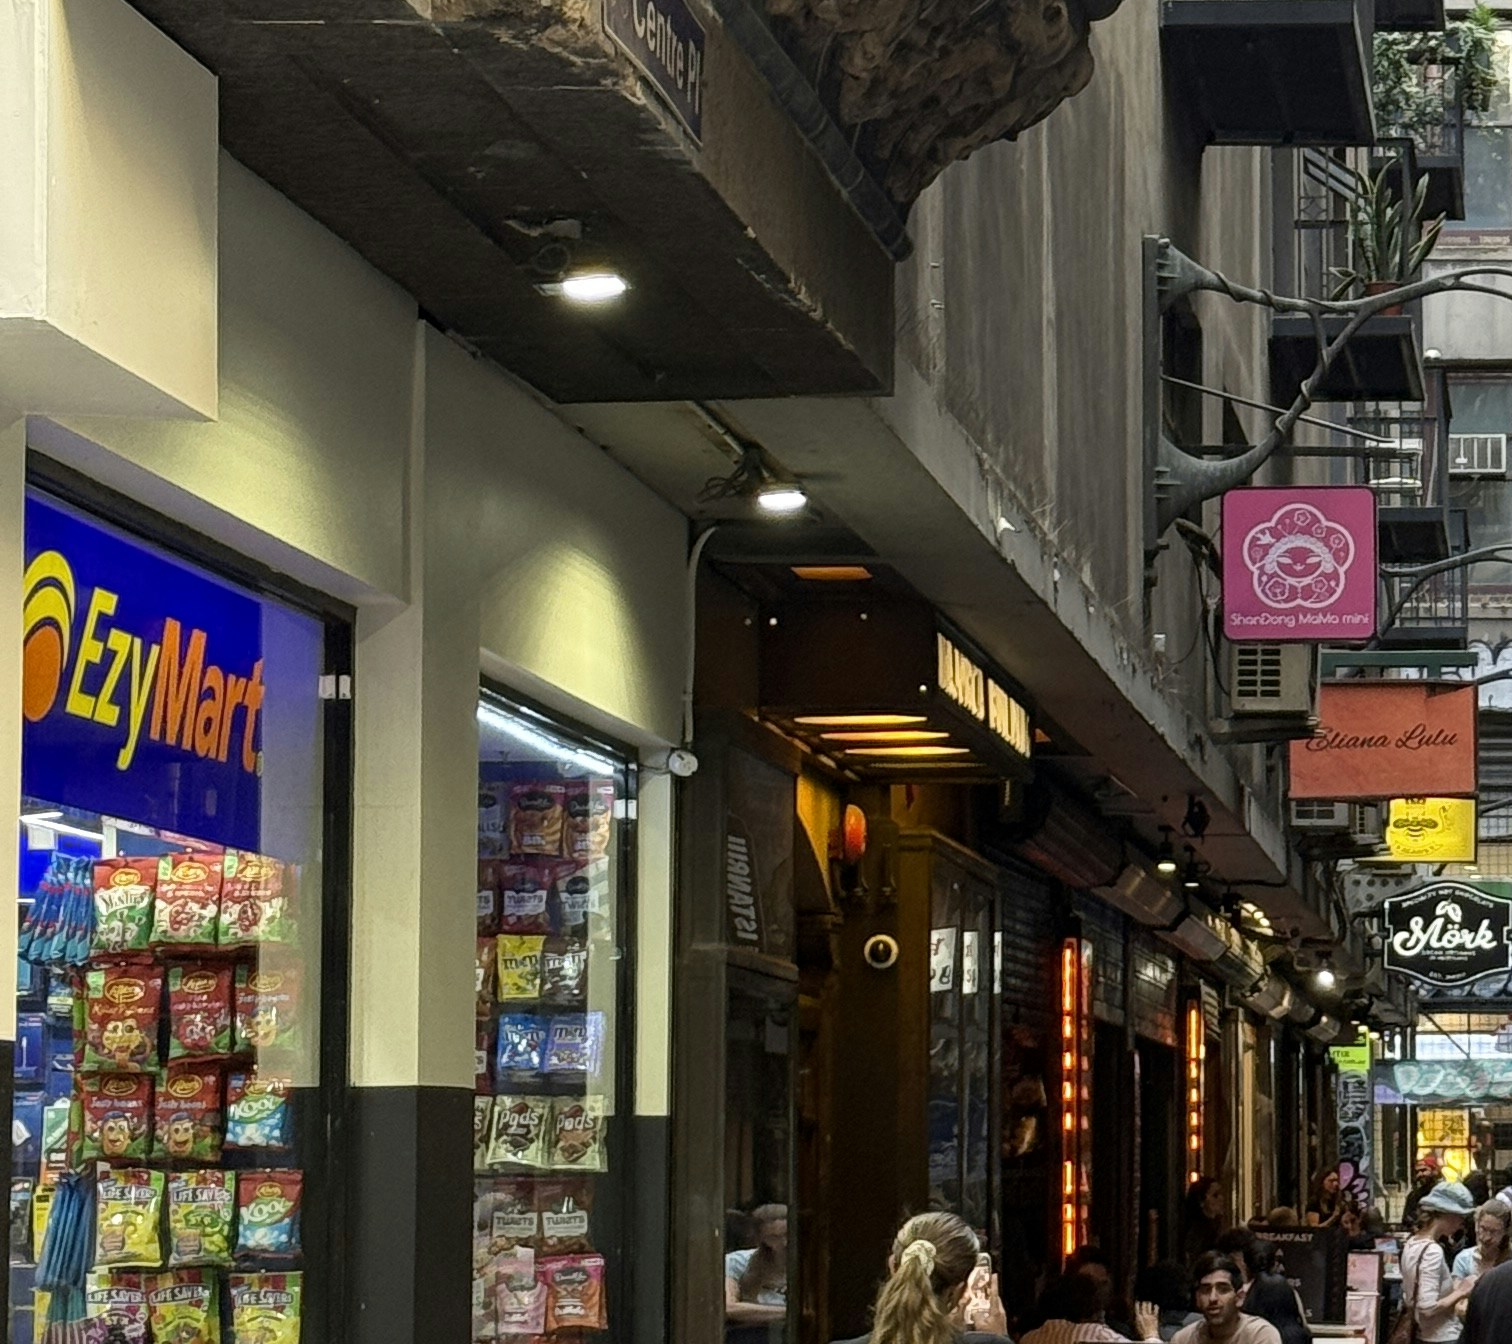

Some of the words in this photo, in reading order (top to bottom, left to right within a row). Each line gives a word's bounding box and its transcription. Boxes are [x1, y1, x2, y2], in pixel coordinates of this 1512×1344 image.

[1230, 612, 1296, 628] ShanDong
[1298, 612, 1340, 625] MaMa
[1342, 612, 1370, 625] mini
[1305, 727, 1390, 752] Eliana
[1395, 723, 1458, 751] Lulu
[1256, 1233, 1313, 1243] BREAKFAST
